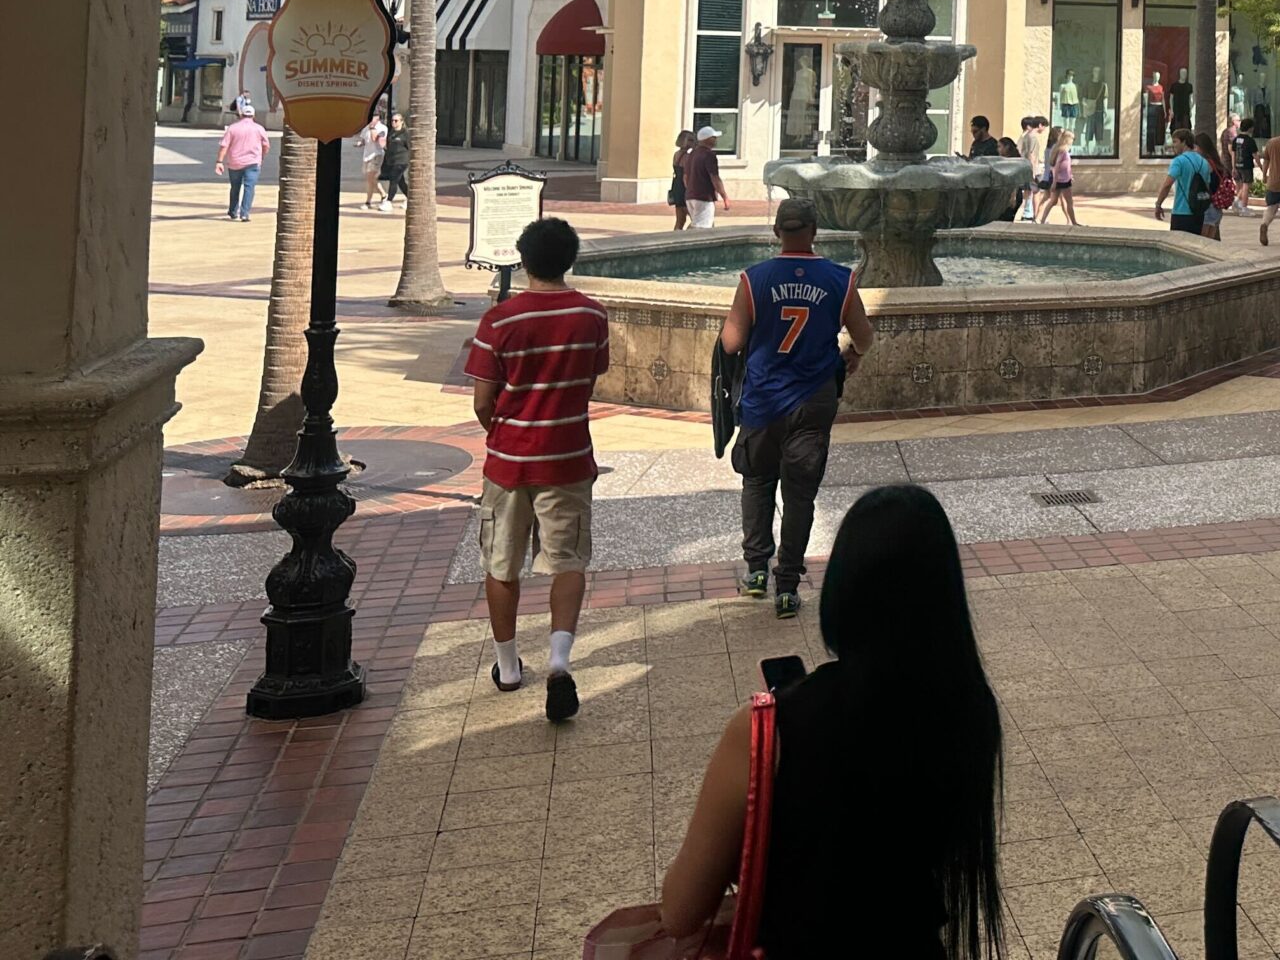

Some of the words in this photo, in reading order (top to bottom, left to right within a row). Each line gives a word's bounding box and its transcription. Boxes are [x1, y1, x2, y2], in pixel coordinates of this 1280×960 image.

[285, 57, 370, 80] SUMMER
[297, 80, 324, 88] DISNEY
[770, 283, 828, 305] ANTHONY
[777, 305, 810, 354] 7
